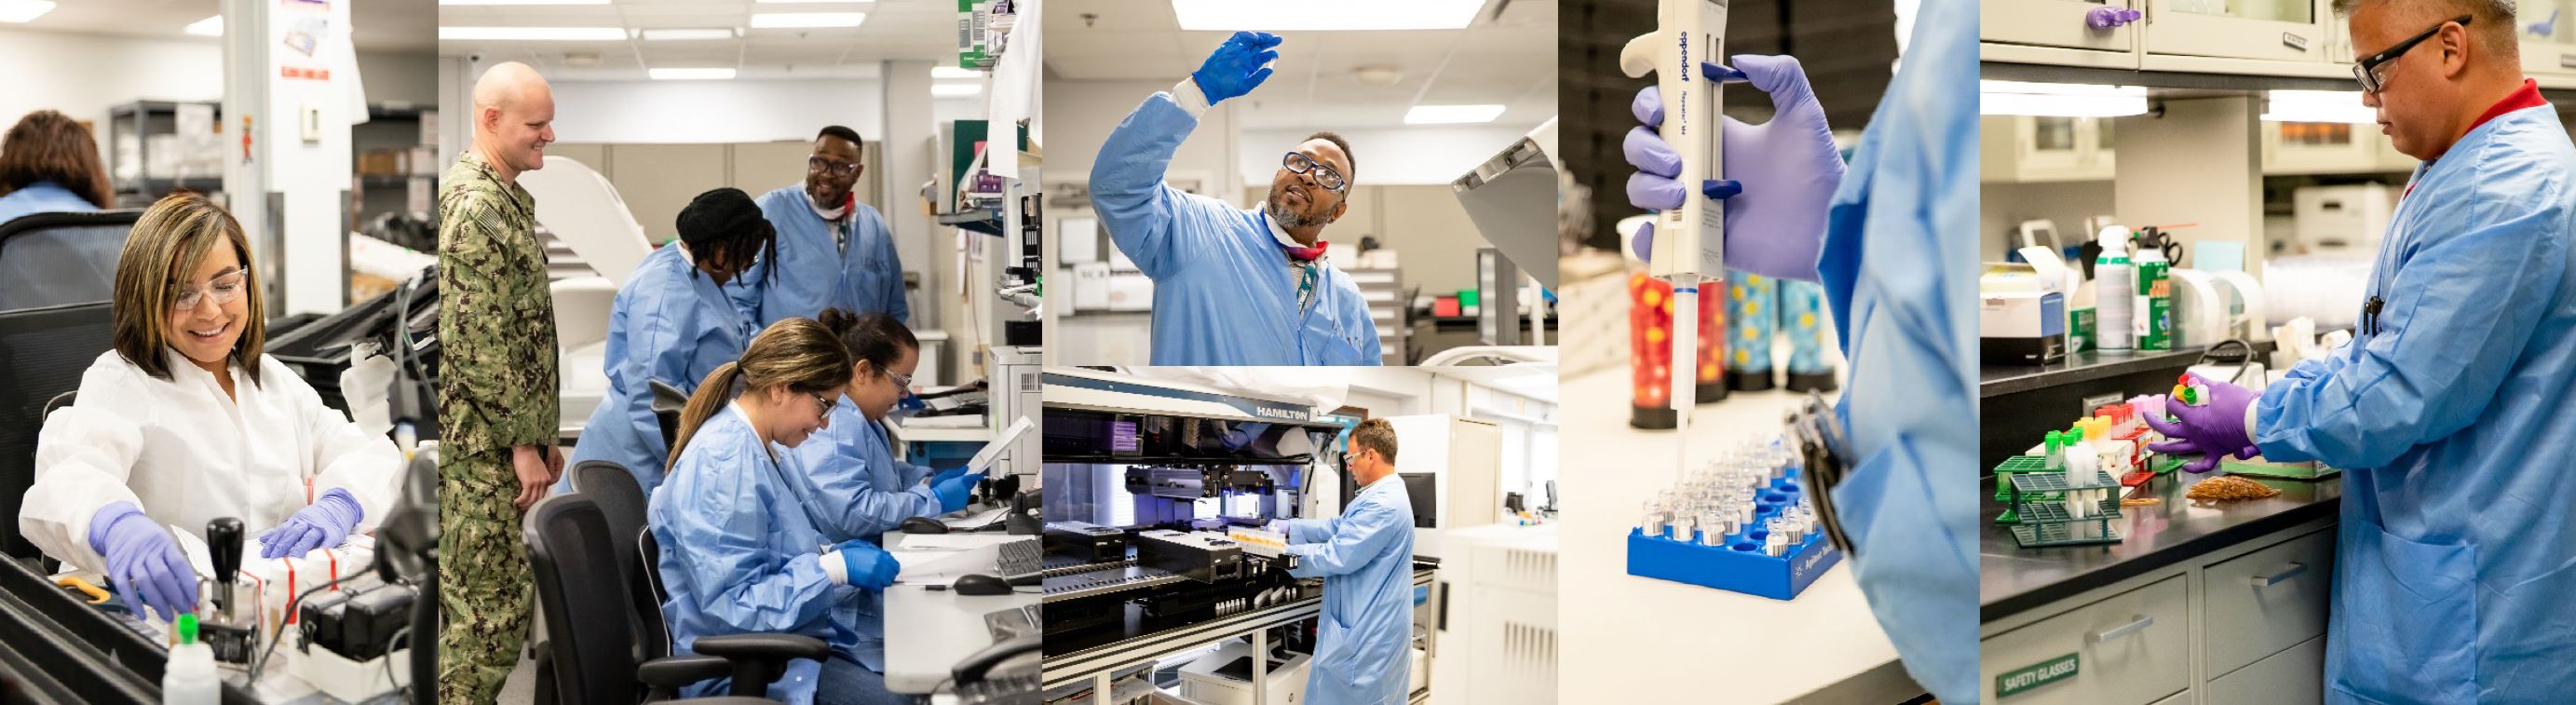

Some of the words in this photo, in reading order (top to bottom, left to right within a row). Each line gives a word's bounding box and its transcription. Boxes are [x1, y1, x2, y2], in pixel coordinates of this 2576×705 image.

[1679, 31, 1689, 81] eppendorf
[1256, 406, 1308, 420] HAMILTON
[2004, 671, 2037, 691] SAFETY
[2038, 658, 2076, 681] GLASSES
